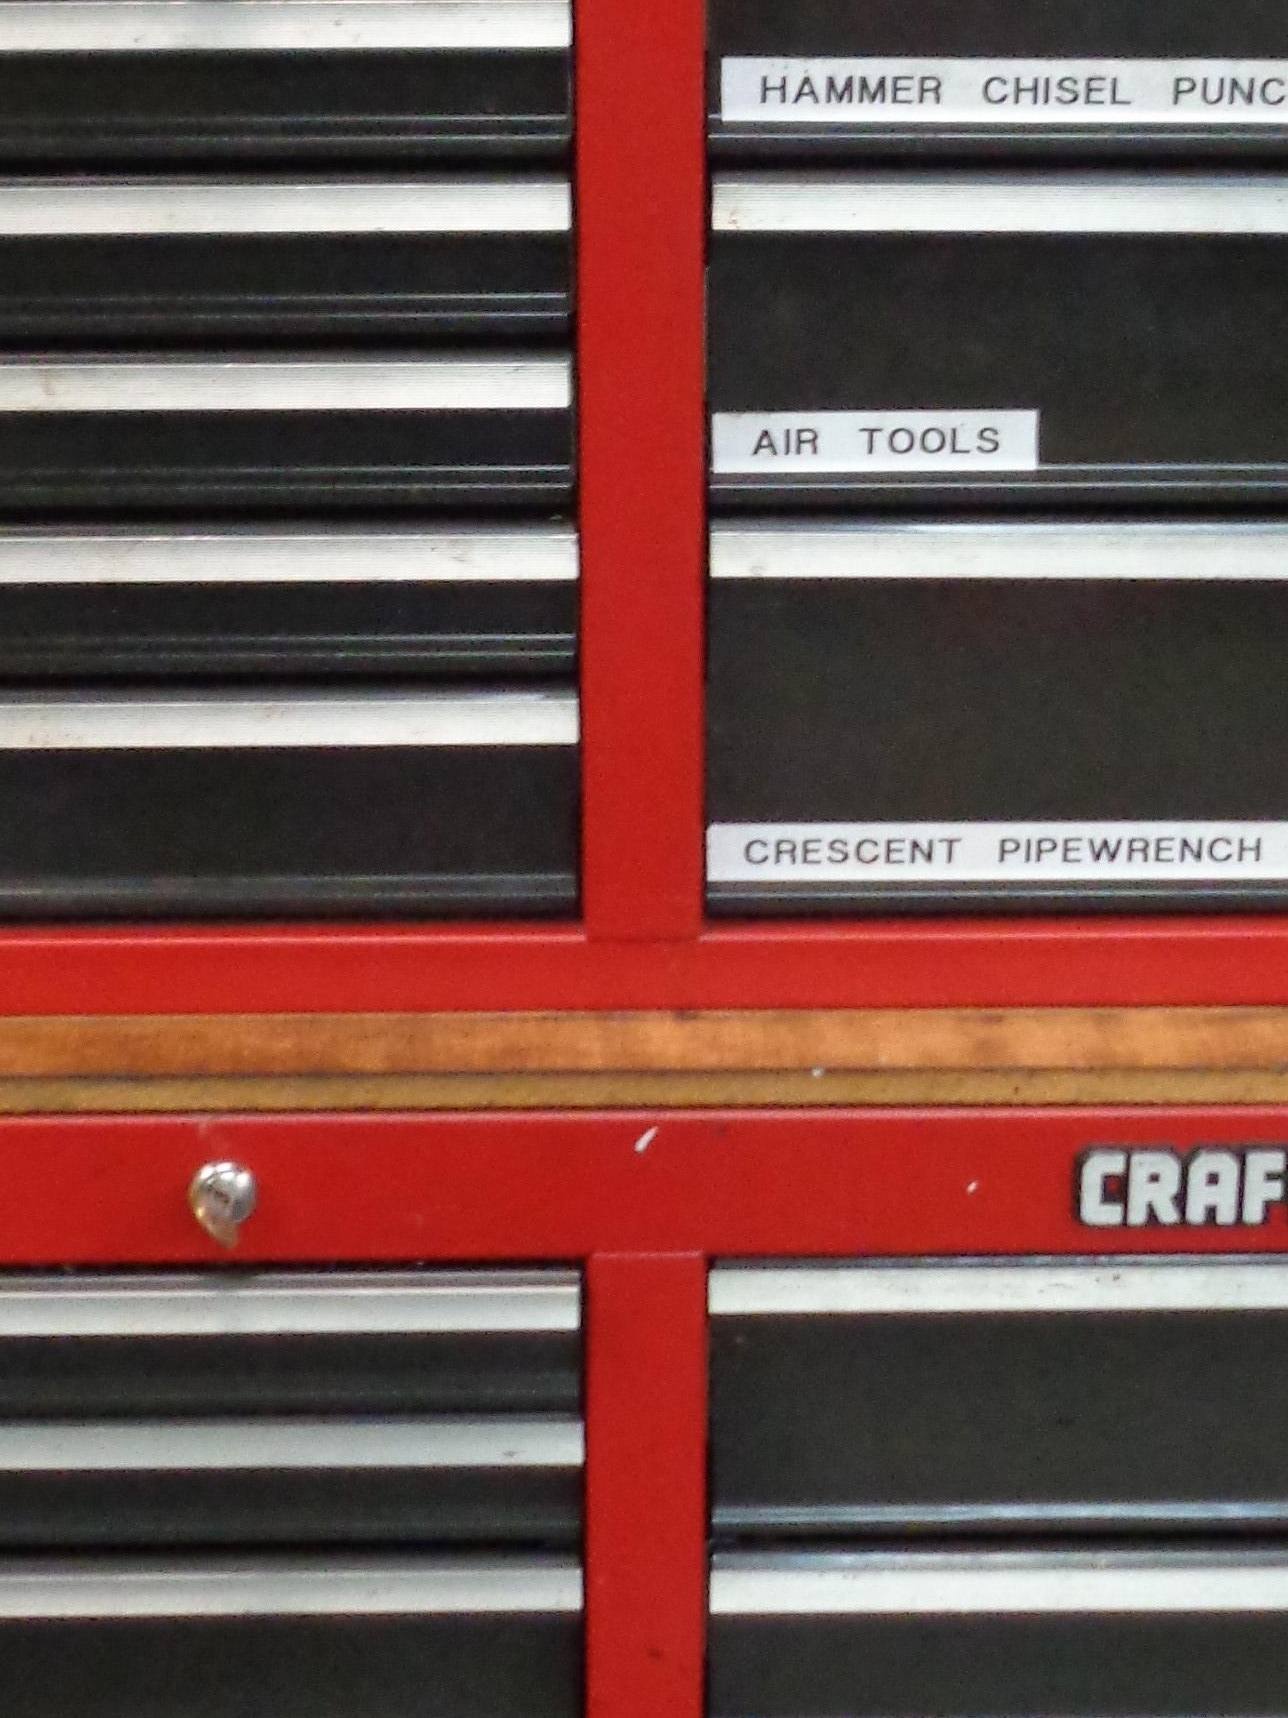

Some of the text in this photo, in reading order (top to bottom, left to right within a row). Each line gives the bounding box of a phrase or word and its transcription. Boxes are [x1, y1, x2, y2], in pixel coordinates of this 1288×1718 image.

[760, 75, 942, 105] HAMMER
[982, 76, 1132, 105] CHISEL
[752, 426, 1000, 456] AIR TOOLS
[743, 837, 1262, 865] CRESCENT PIPEWRENCH
